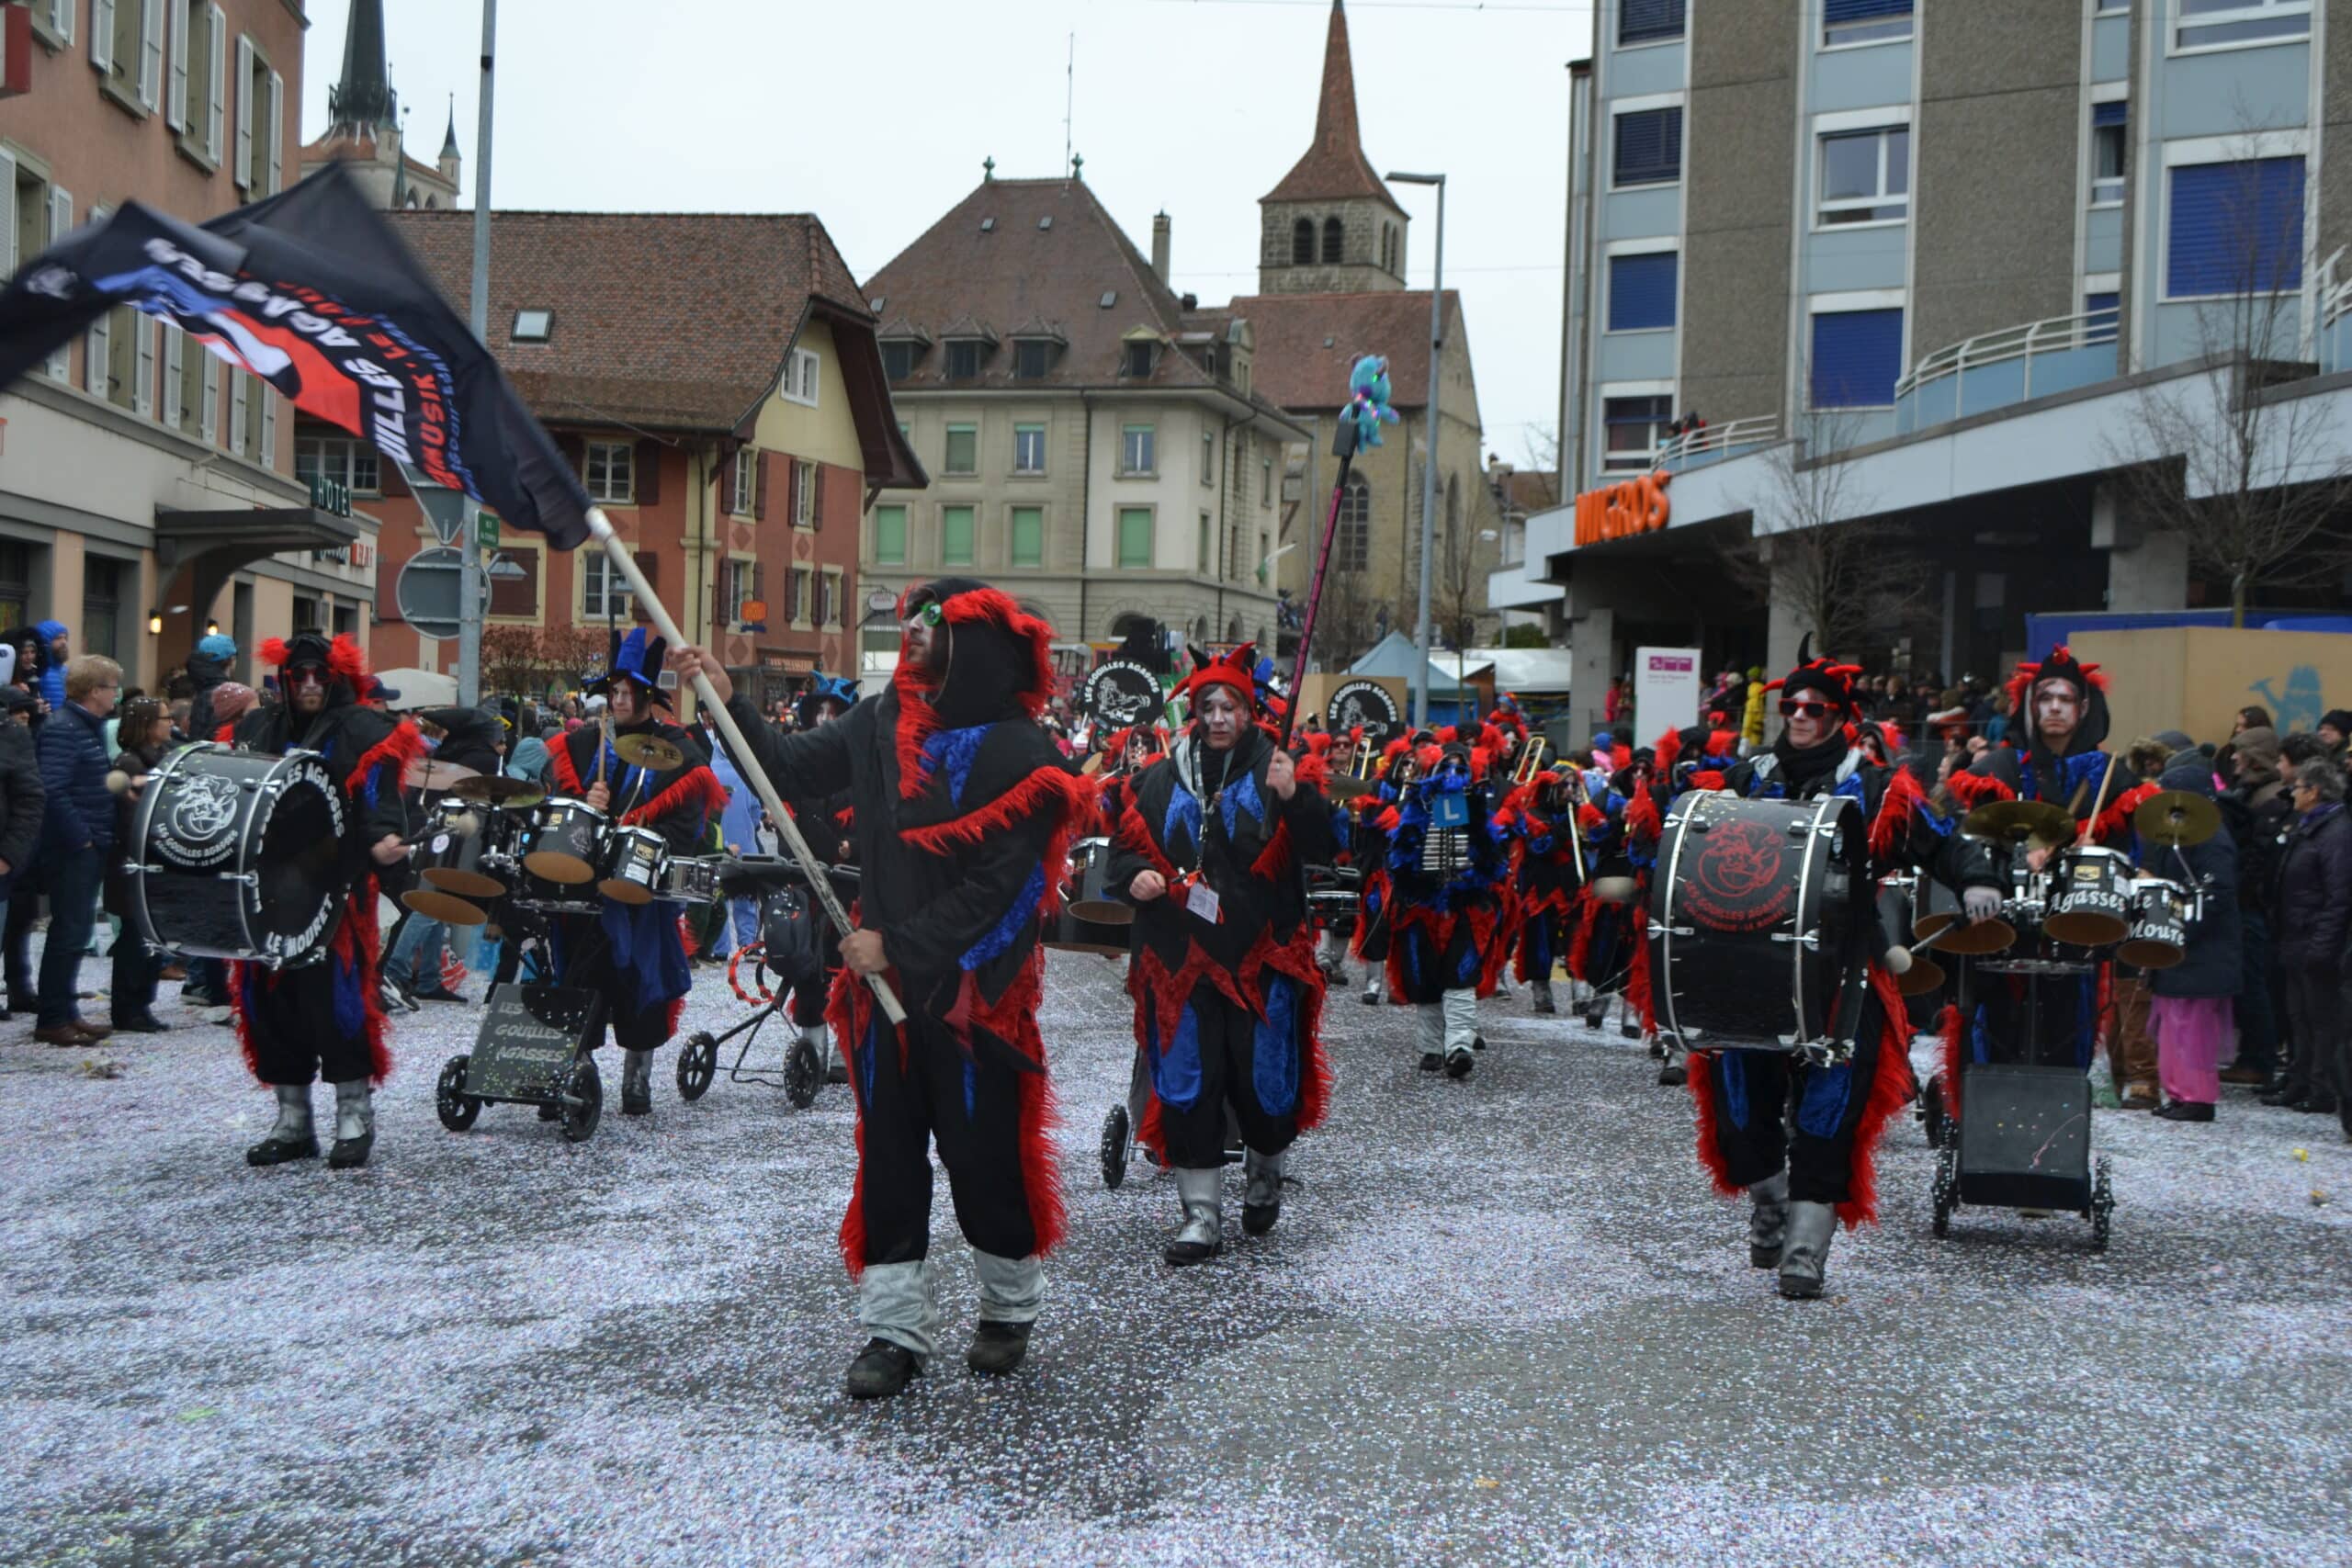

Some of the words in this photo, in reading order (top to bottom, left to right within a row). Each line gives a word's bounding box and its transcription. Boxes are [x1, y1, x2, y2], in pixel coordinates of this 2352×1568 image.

[143, 238, 361, 347] AGASSES
[317, 476, 353, 517] HOTEL
[1574, 469, 1671, 547] MIGROS
[1088, 660, 1125, 685] GOUILLES
[1127, 662, 1159, 694] AGASSES
[1084, 685, 1093, 703] LES
[1329, 703, 1339, 719] LES
[1334, 682, 1372, 703] GOUILLES
[305, 761, 345, 838] AGASSES
[1443, 798, 1460, 821] L
[157, 822, 170, 839] LES
[165, 837, 202, 858] GOUILLES
[2045, 889, 2127, 917] Agasses
[265, 931, 283, 954] LE
[284, 892, 334, 958] MOURET
[497, 1001, 525, 1015] LES
[494, 1023, 565, 1040] GOUILLES
[496, 1047, 567, 1062] AGASSES
